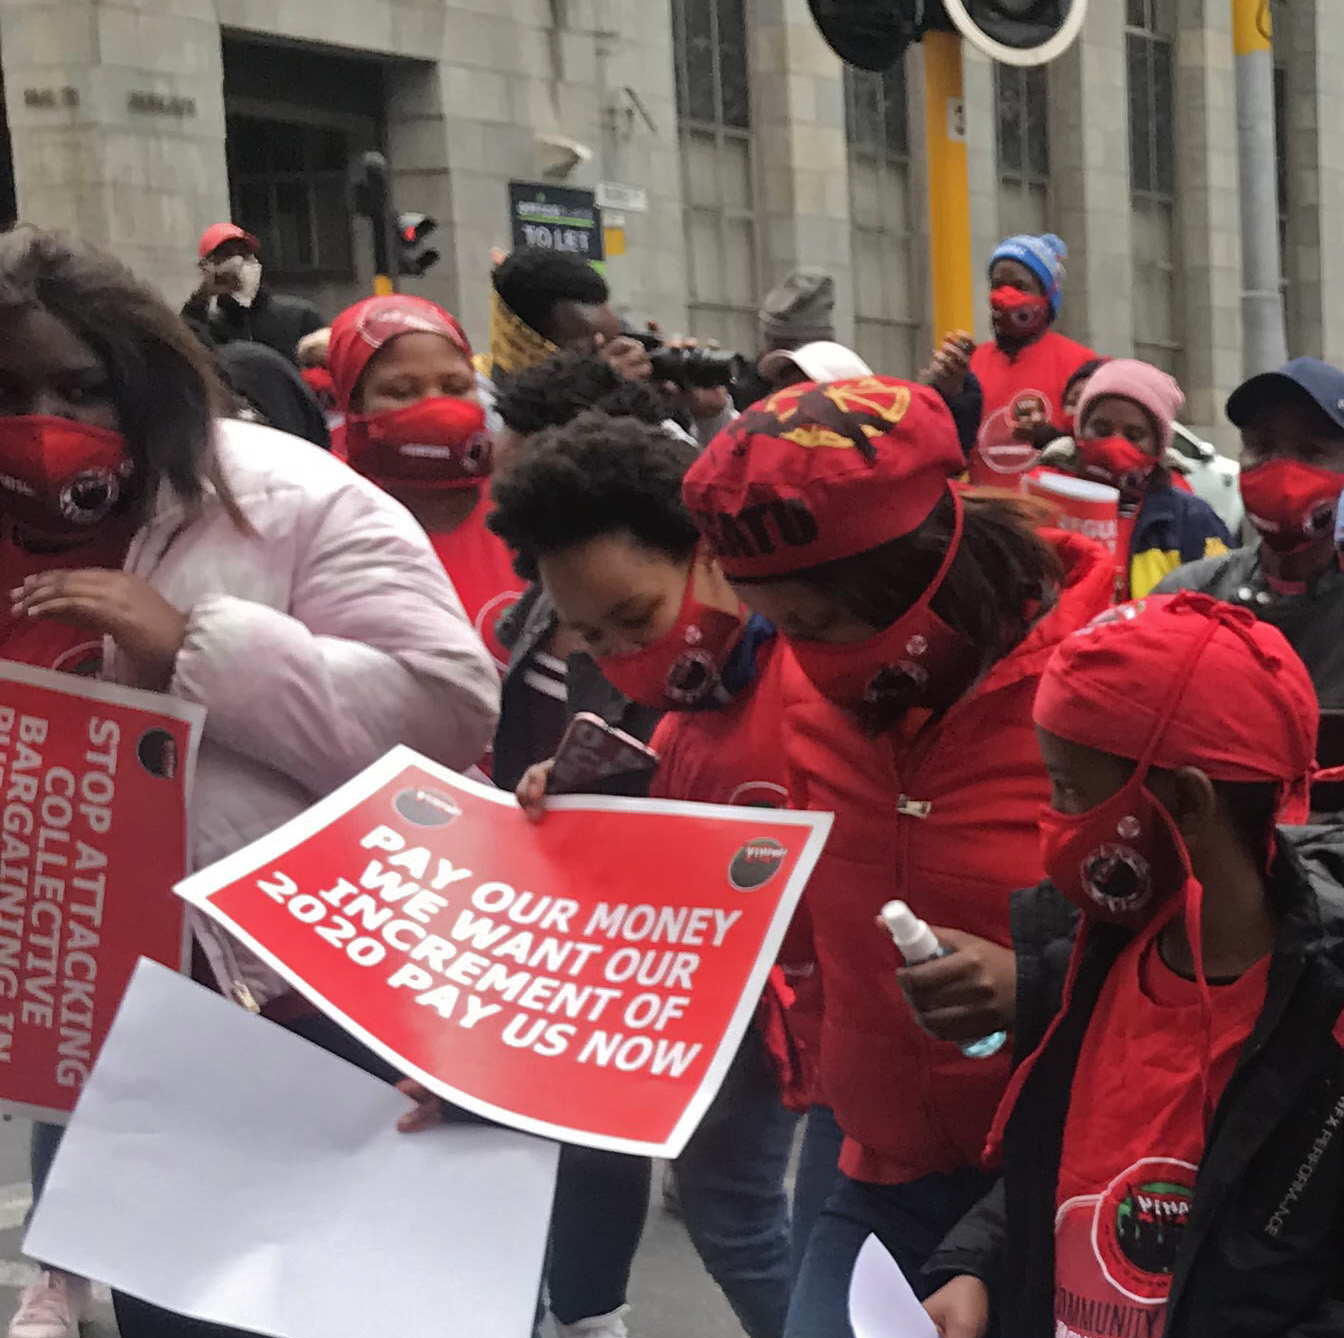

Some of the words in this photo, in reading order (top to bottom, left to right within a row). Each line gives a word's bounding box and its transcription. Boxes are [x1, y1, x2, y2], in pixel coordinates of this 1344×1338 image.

[80, 716, 121, 833] STOP
[0, 715, 49, 999] BARGAINING
[21, 766, 76, 1029] COLLECTIVE
[360, 825, 471, 889] PAY
[470, 882, 578, 933] OUR
[583, 902, 742, 947] MONEY
[360, 859, 449, 923] WE
[451, 908, 603, 973] WANT
[603, 948, 701, 990] OUR
[55, 840, 109, 1088] ATTACKING
[256, 871, 386, 967] 2020
[387, 963, 502, 1029] PAY
[501, 1018, 578, 1058] US
[577, 1033, 703, 1078] NOW
[319, 877, 619, 1022] INCREMENT
[623, 993, 691, 1032] OF
[1137, 1195, 1191, 1216] NEHA
